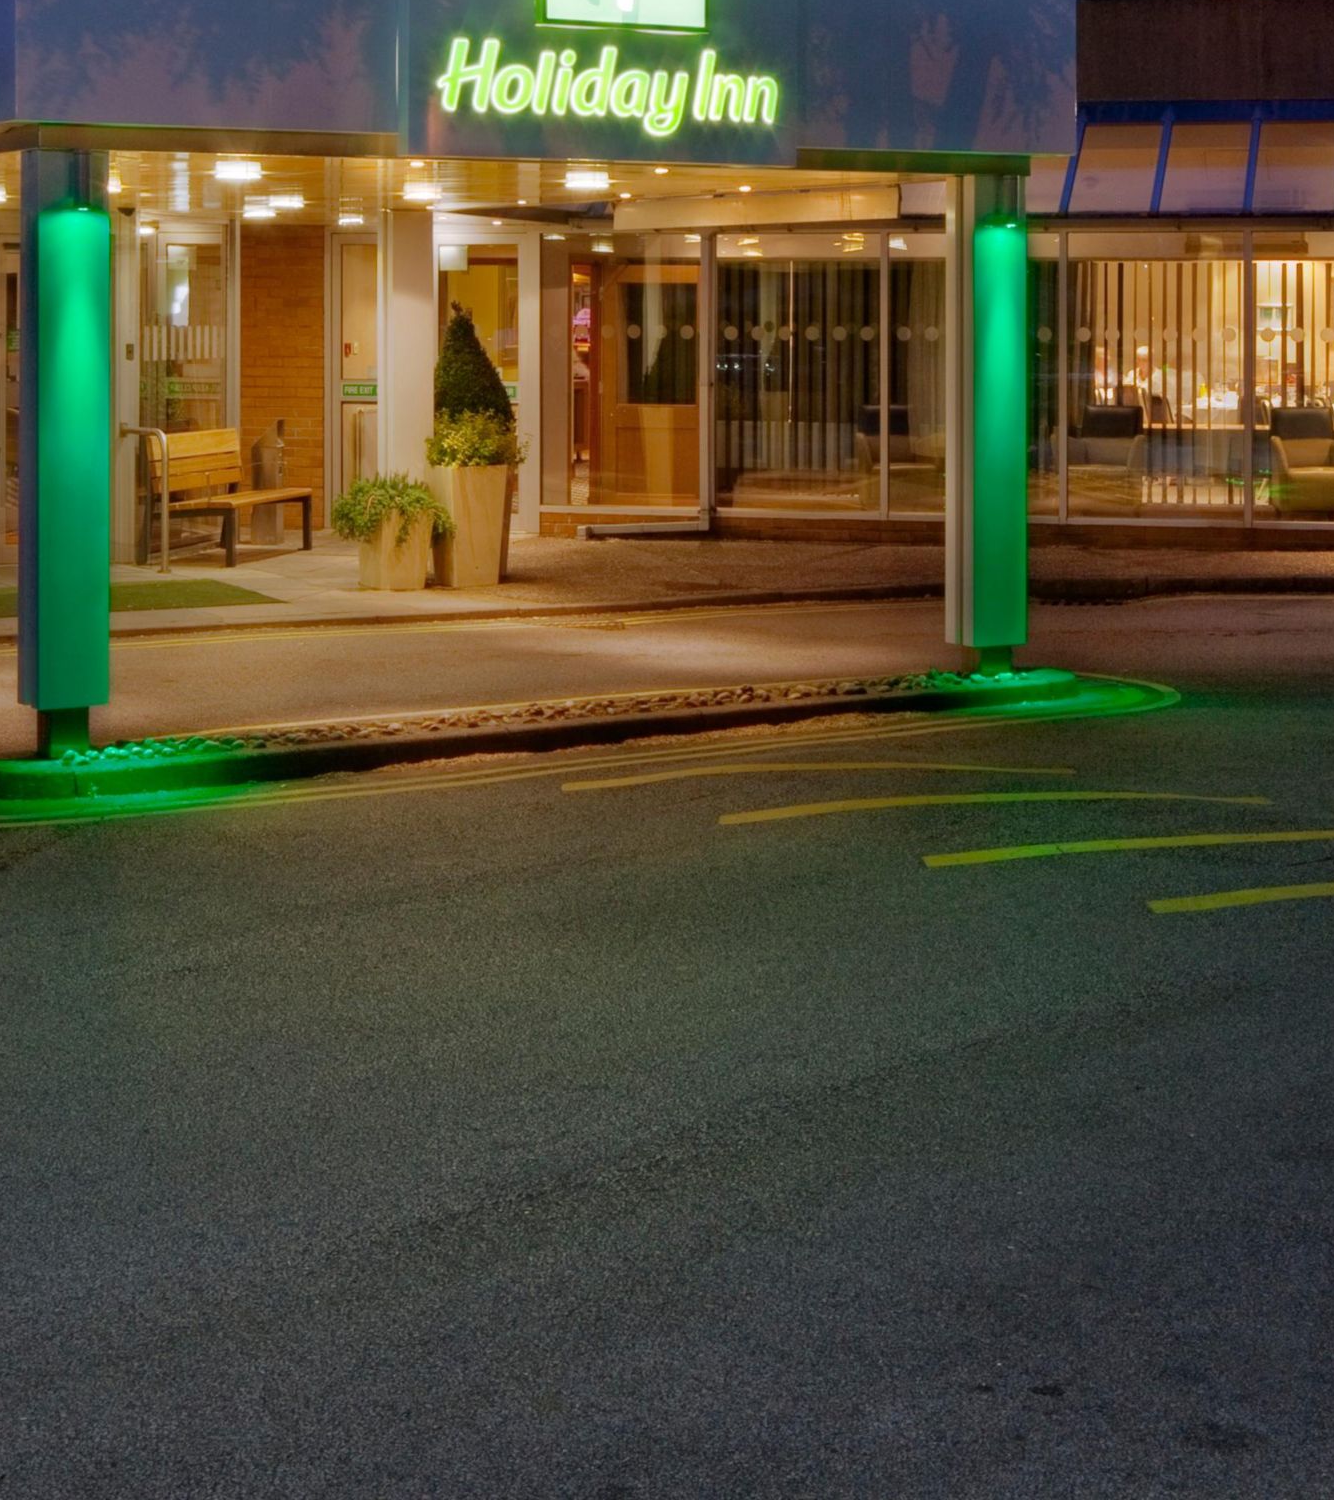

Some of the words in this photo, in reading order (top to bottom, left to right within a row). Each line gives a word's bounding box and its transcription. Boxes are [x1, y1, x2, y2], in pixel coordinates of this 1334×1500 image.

[437, 37, 689, 137] Holiday
[692, 48, 779, 125] Inn
[344, 386, 358, 395] FIRE
[359, 386, 373, 395] EXIT
